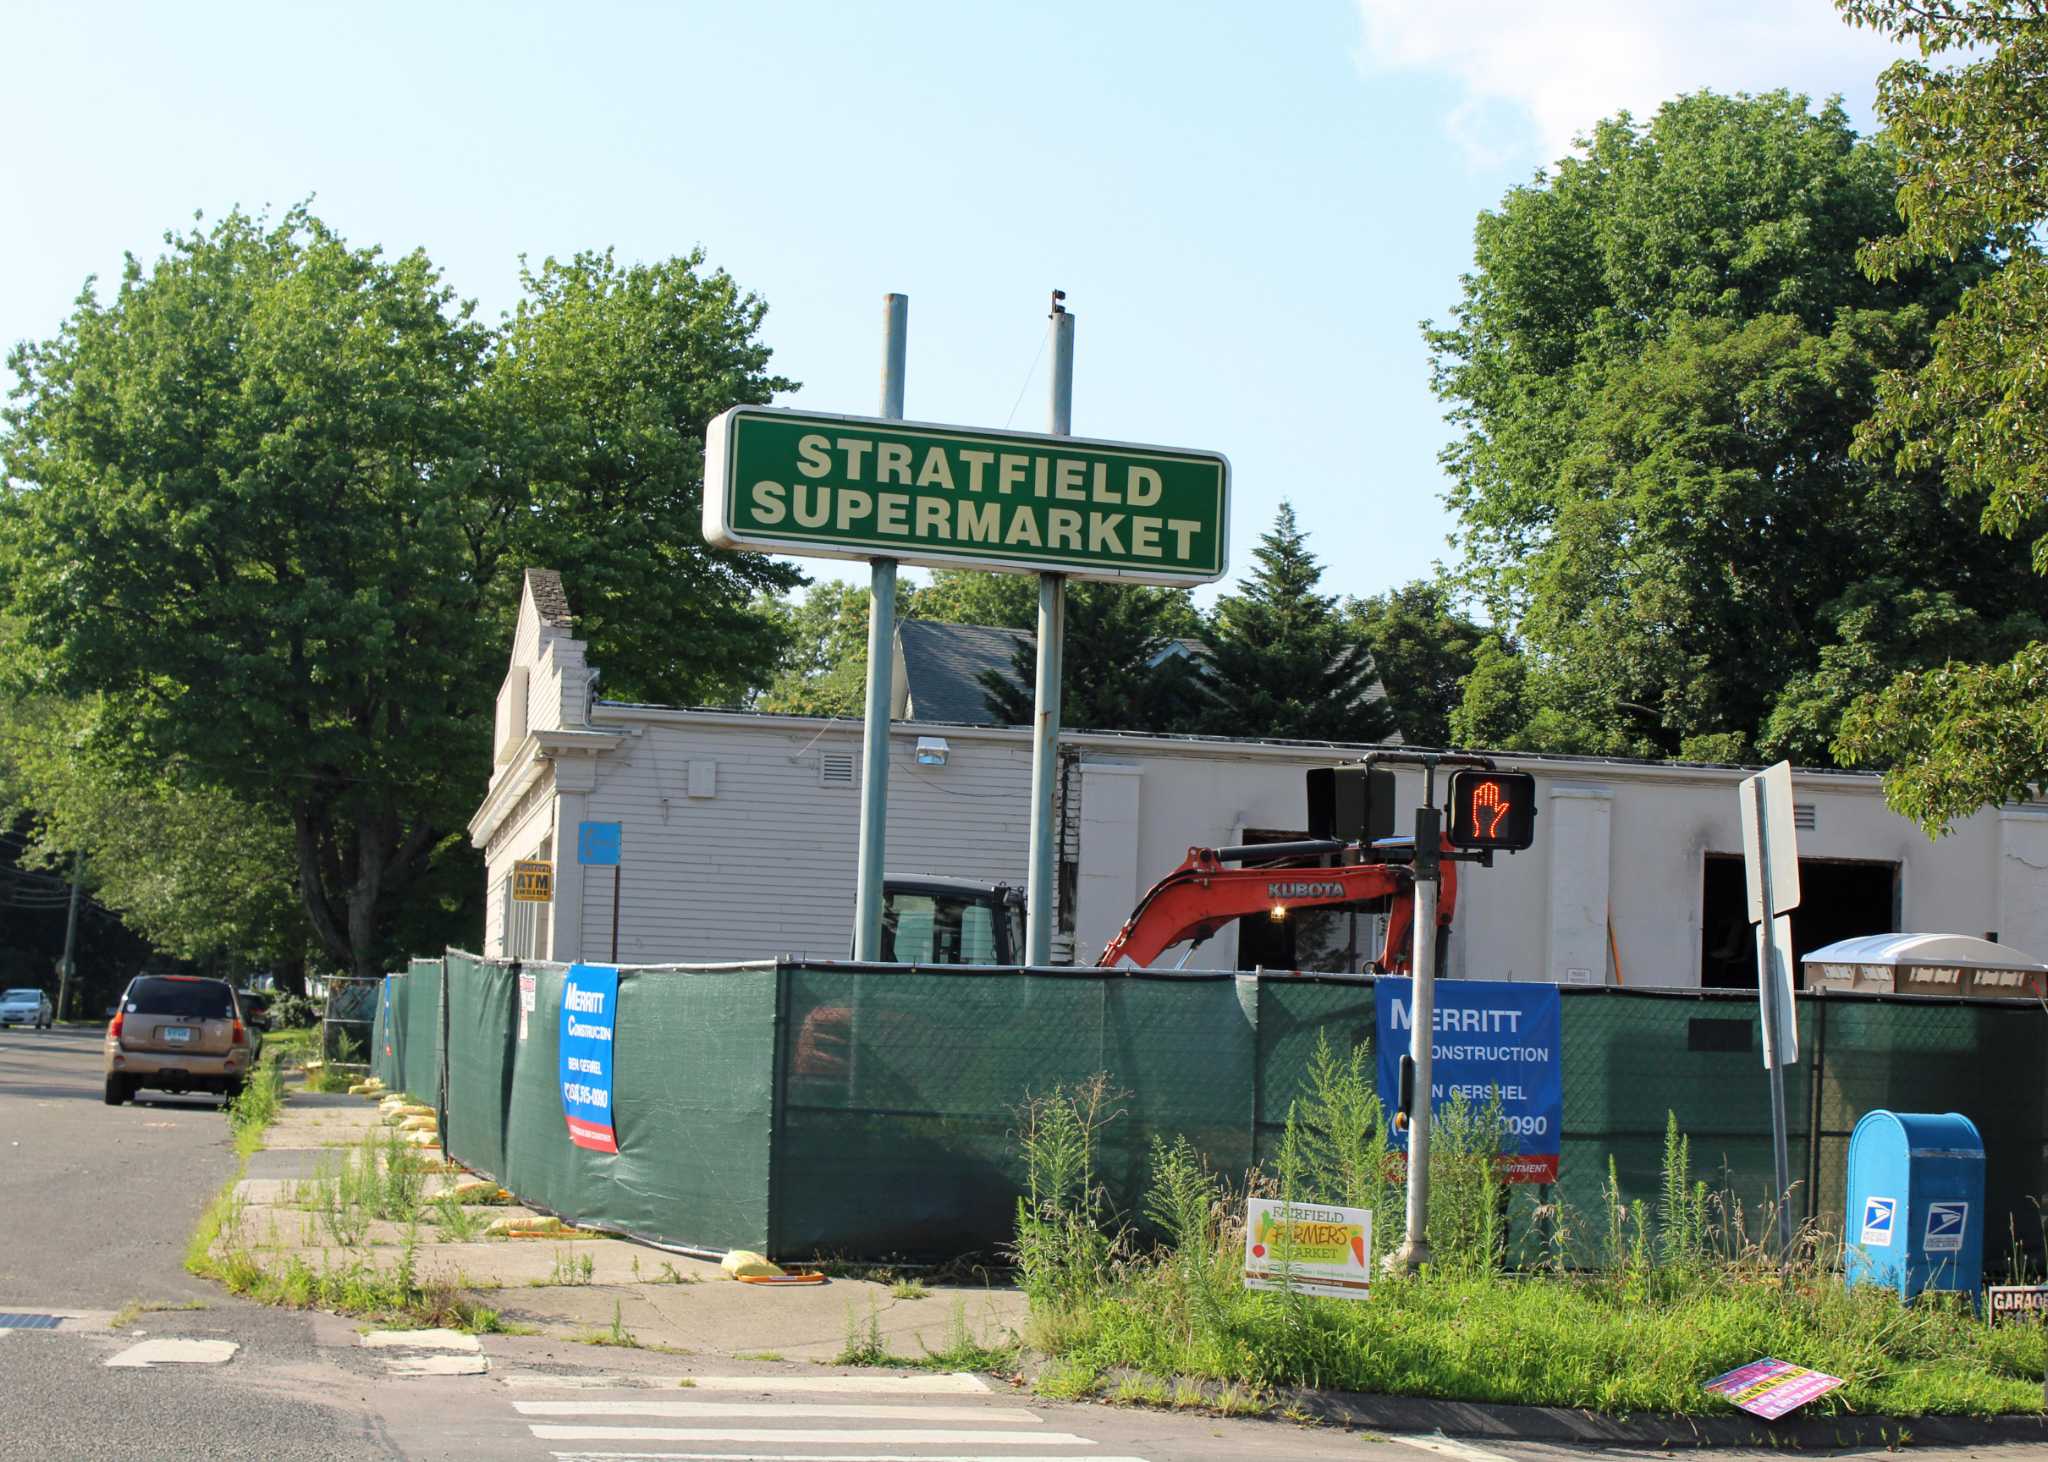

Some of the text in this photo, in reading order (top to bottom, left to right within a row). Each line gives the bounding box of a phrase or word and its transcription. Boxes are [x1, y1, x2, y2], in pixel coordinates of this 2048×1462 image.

[797, 434, 1163, 507] STRATFIELD
[751, 480, 1202, 560] SUPERMARKET
[516, 874, 549, 889] ATM
[1267, 882, 1346, 898] KUBOTA
[565, 981, 605, 1014] MERRITT
[1429, 1043, 1549, 1062] ONSTRUCTION
